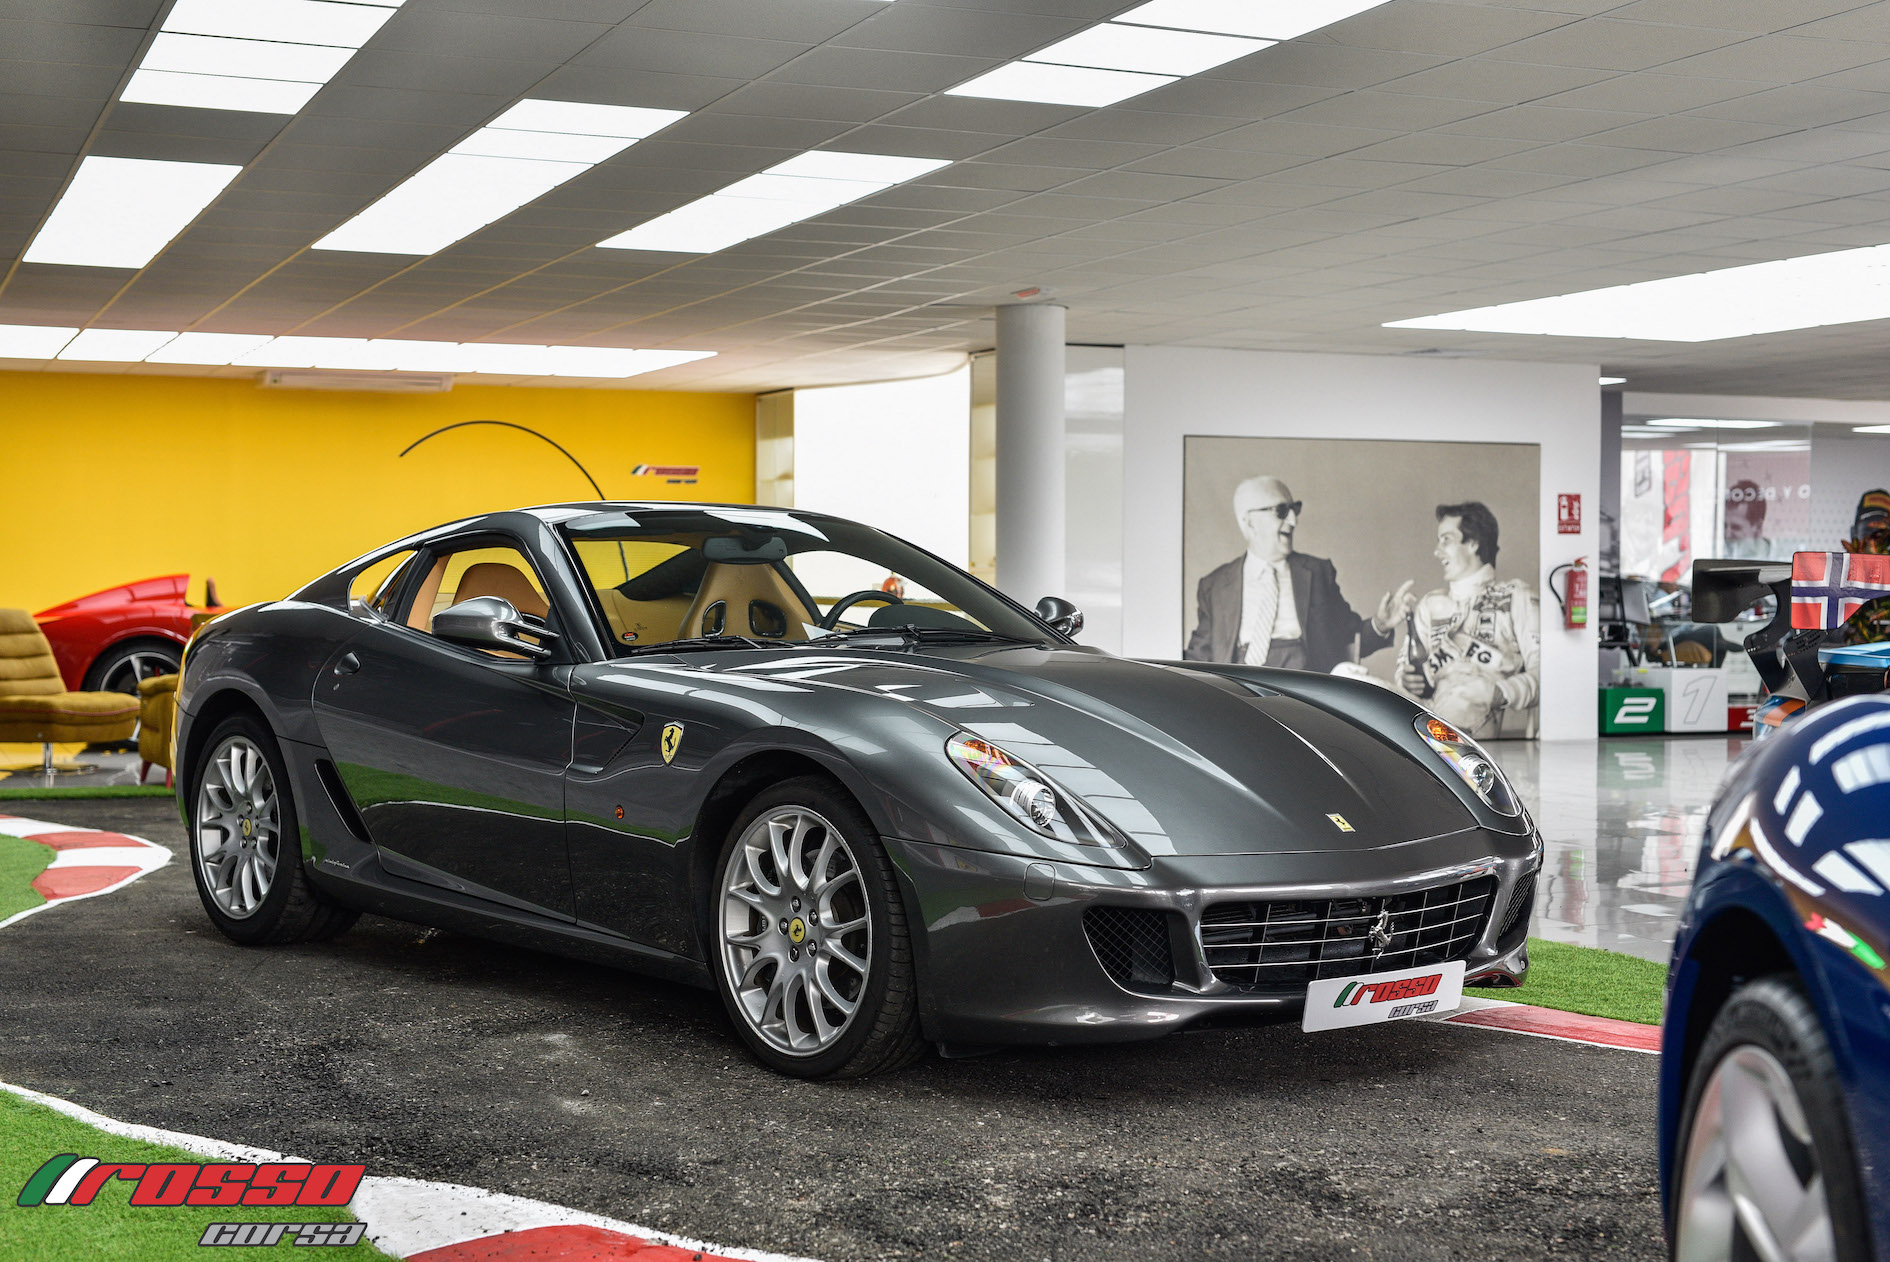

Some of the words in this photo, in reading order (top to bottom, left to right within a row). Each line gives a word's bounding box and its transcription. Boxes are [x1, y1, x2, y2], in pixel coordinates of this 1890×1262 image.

[1614, 696, 1657, 724] 2
[1683, 676, 1717, 725] 1
[1351, 974, 1443, 1005] rosso
[1388, 1000, 1439, 1019] corsa
